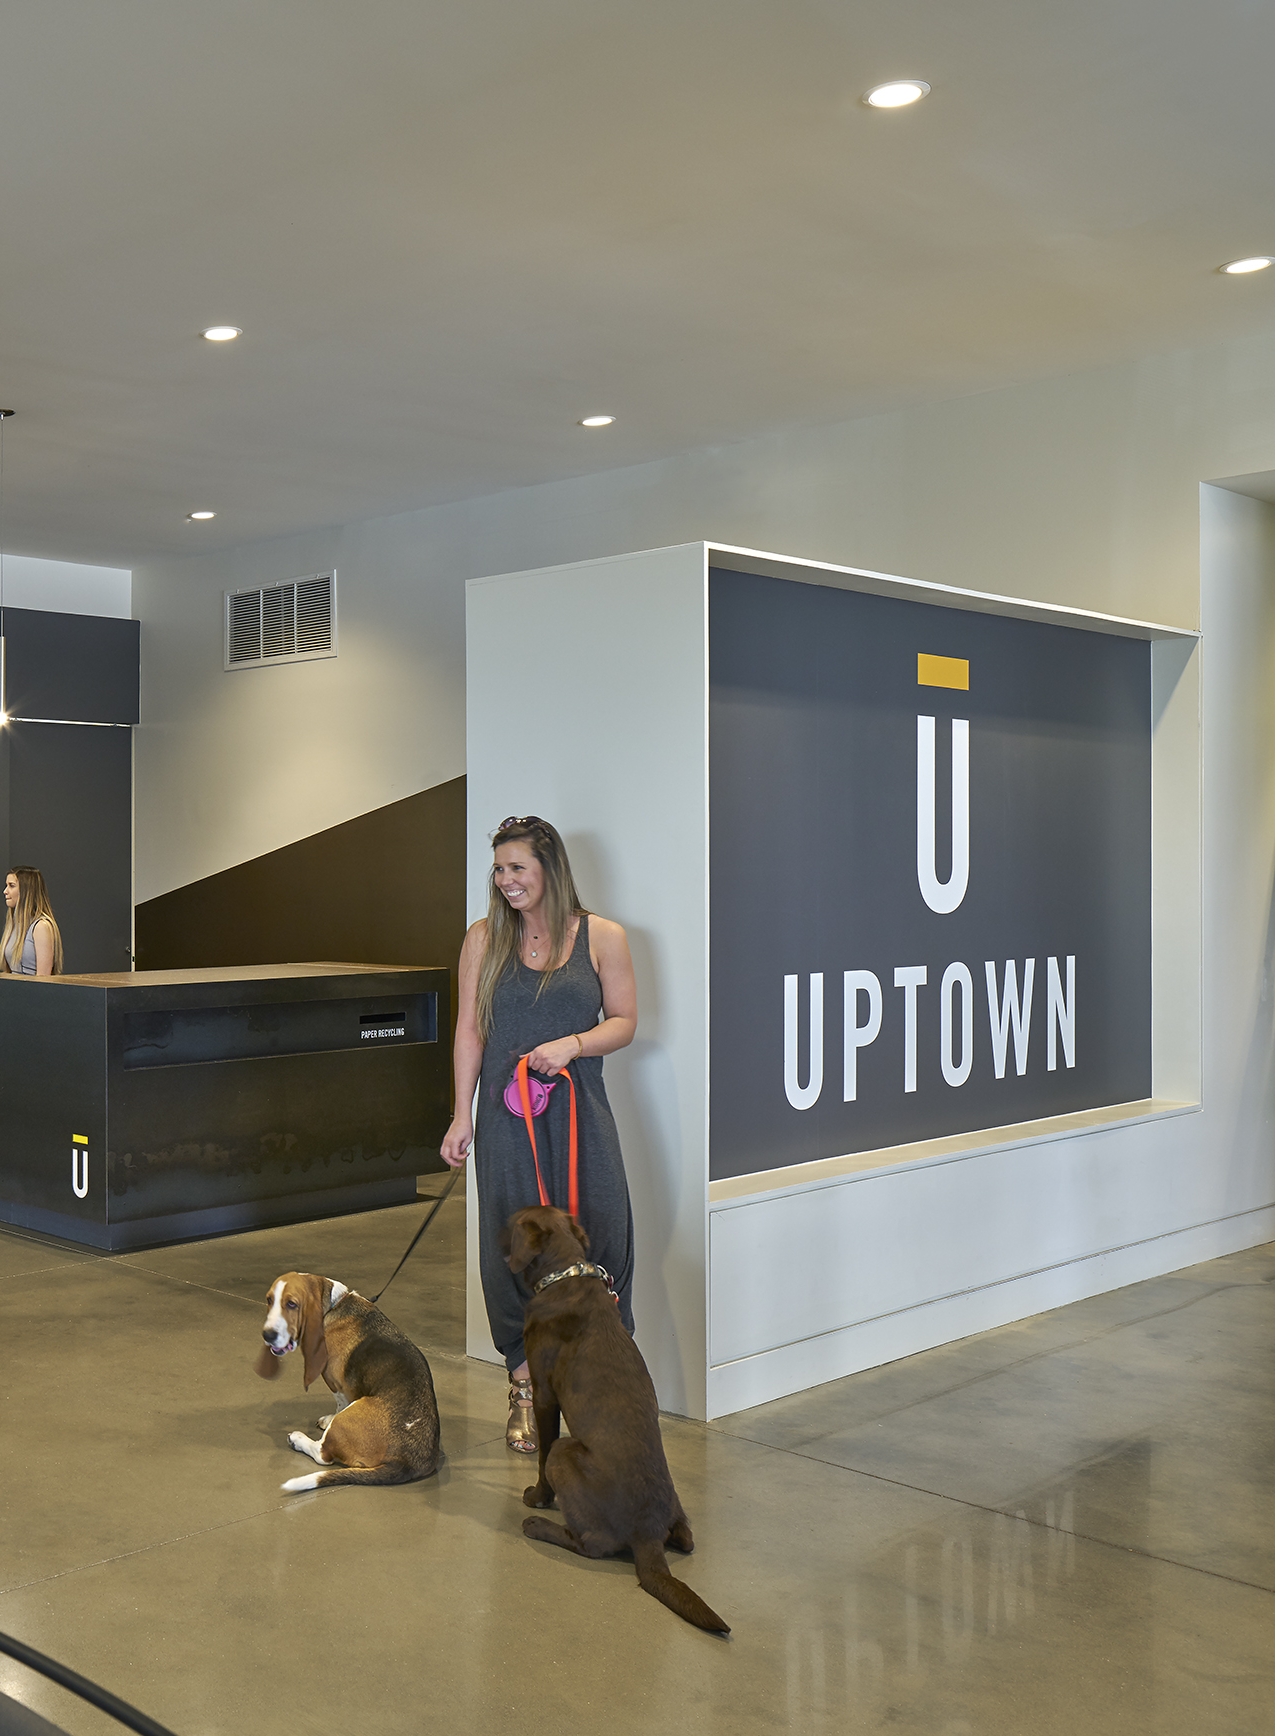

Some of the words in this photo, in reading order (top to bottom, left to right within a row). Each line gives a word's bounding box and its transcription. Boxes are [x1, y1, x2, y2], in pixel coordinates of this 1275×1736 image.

[360, 1030, 377, 1039] PAPER
[377, 1027, 405, 1038] RECYCLING
[783, 955, 1076, 1110] UPTOWN
